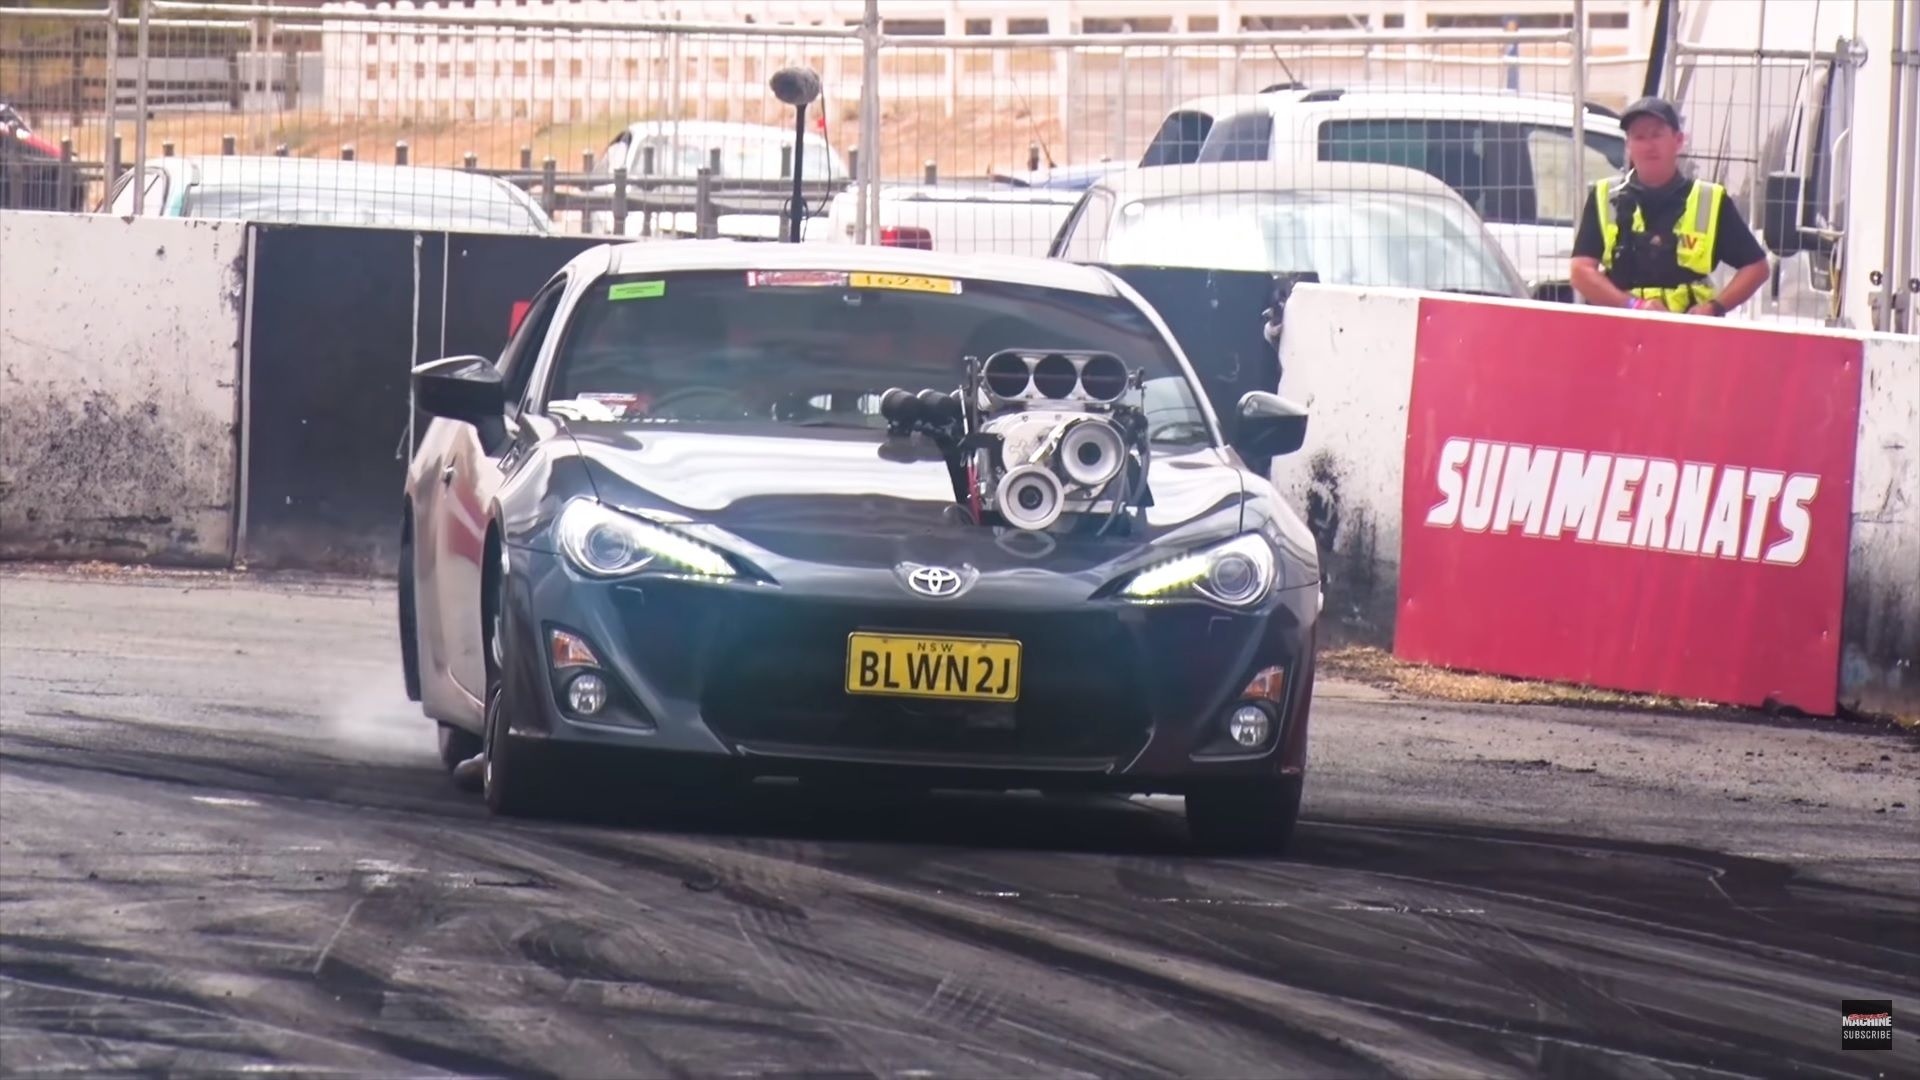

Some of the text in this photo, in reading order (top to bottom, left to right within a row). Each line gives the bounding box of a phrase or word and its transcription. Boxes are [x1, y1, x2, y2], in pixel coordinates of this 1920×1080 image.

[1424, 436, 1821, 566] SUMMERNATS
[917, 642, 954, 653] NSW
[859, 650, 1011, 695] BLWN2J
